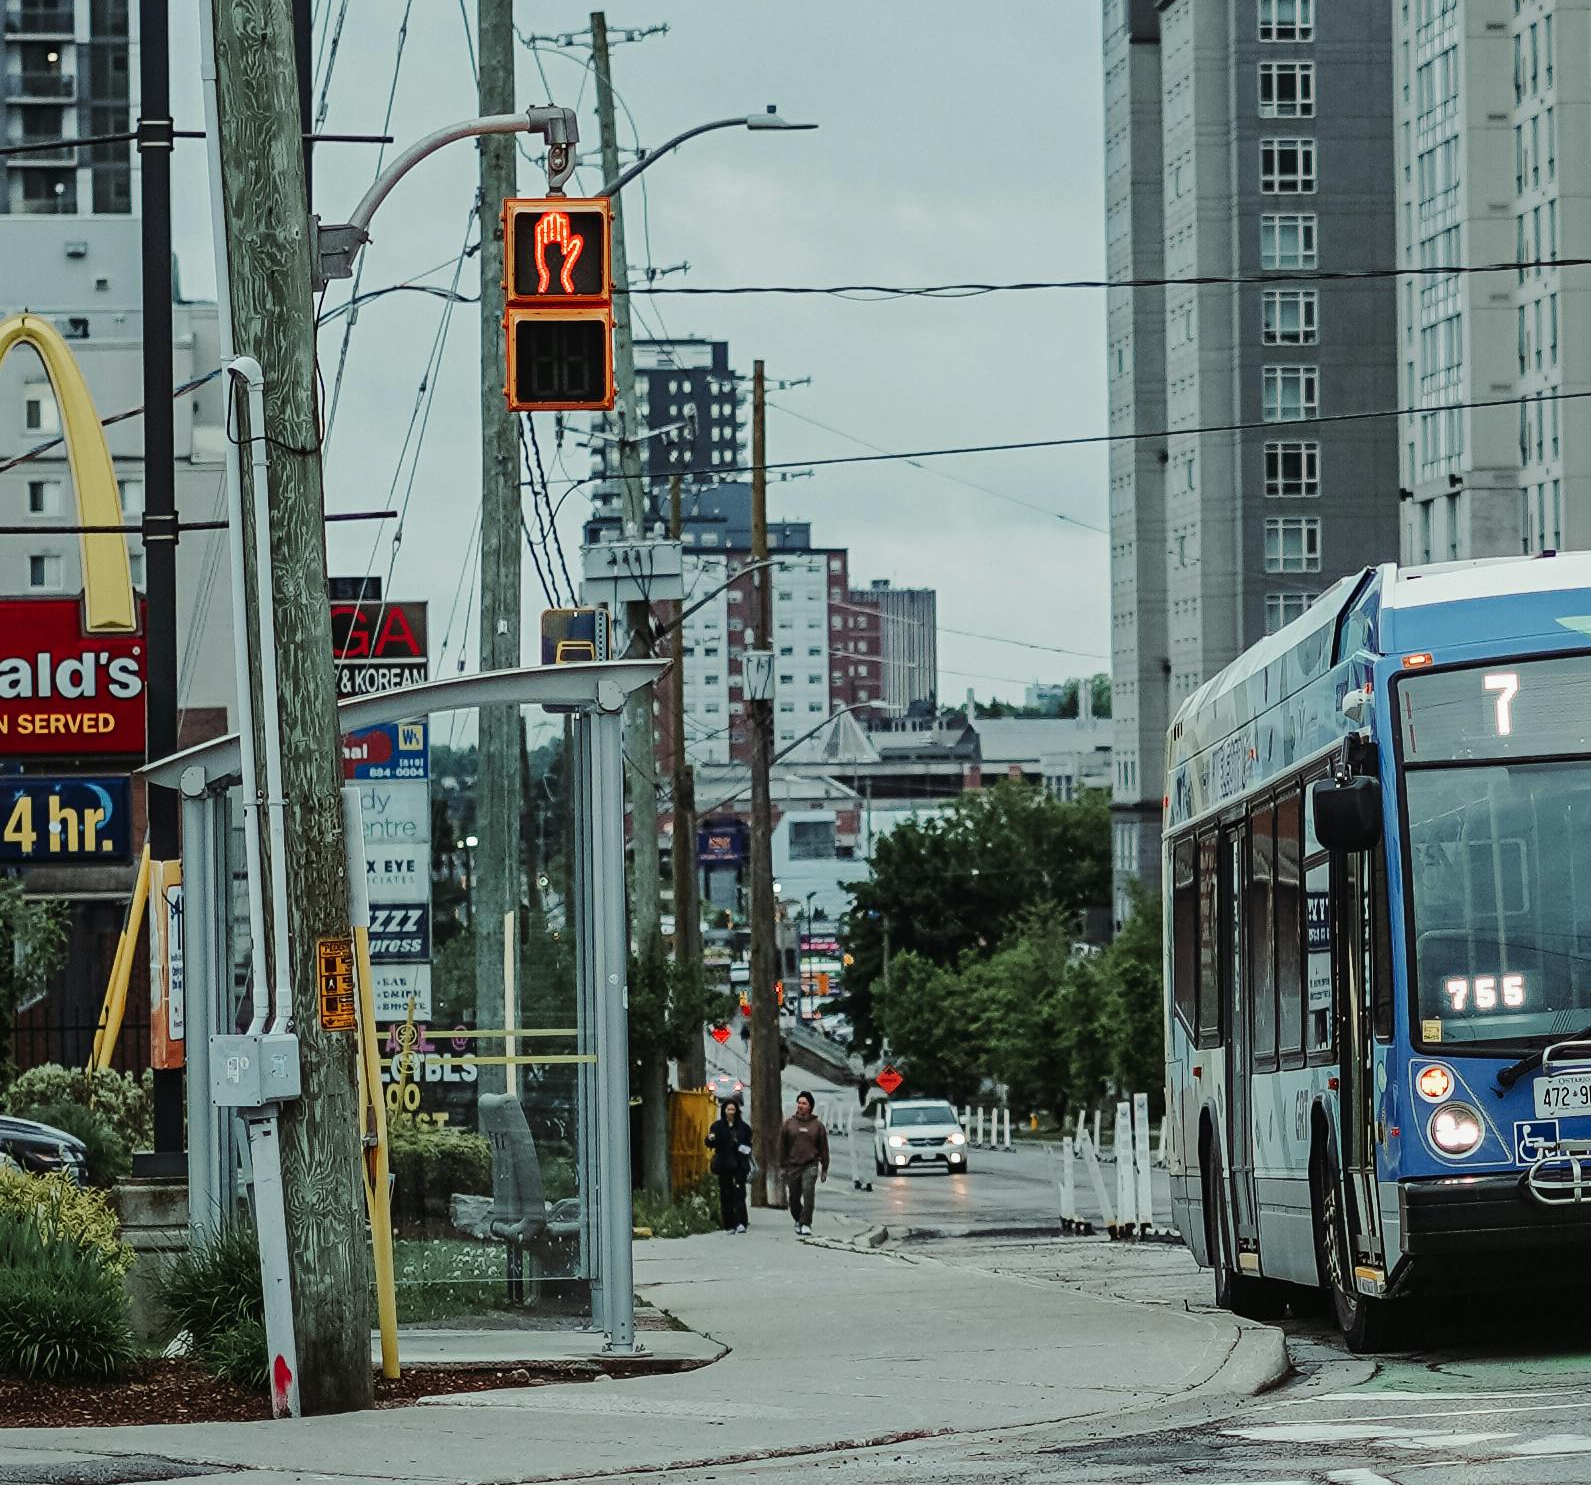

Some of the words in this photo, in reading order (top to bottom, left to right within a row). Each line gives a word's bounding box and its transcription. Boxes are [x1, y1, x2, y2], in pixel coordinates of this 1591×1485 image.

[341, 669, 352, 693] &
[355, 668, 424, 693] KOREAN
[1483, 673, 1518, 736] 7
[17, 713, 115, 734] SERVED
[4, 796, 37, 853] 4
[49, 795, 113, 853] hr.
[384, 860, 415, 873] EYE
[367, 876, 415, 884] CIATES
[369, 910, 423, 932] ZZZ
[1446, 975, 1525, 1011] 755
